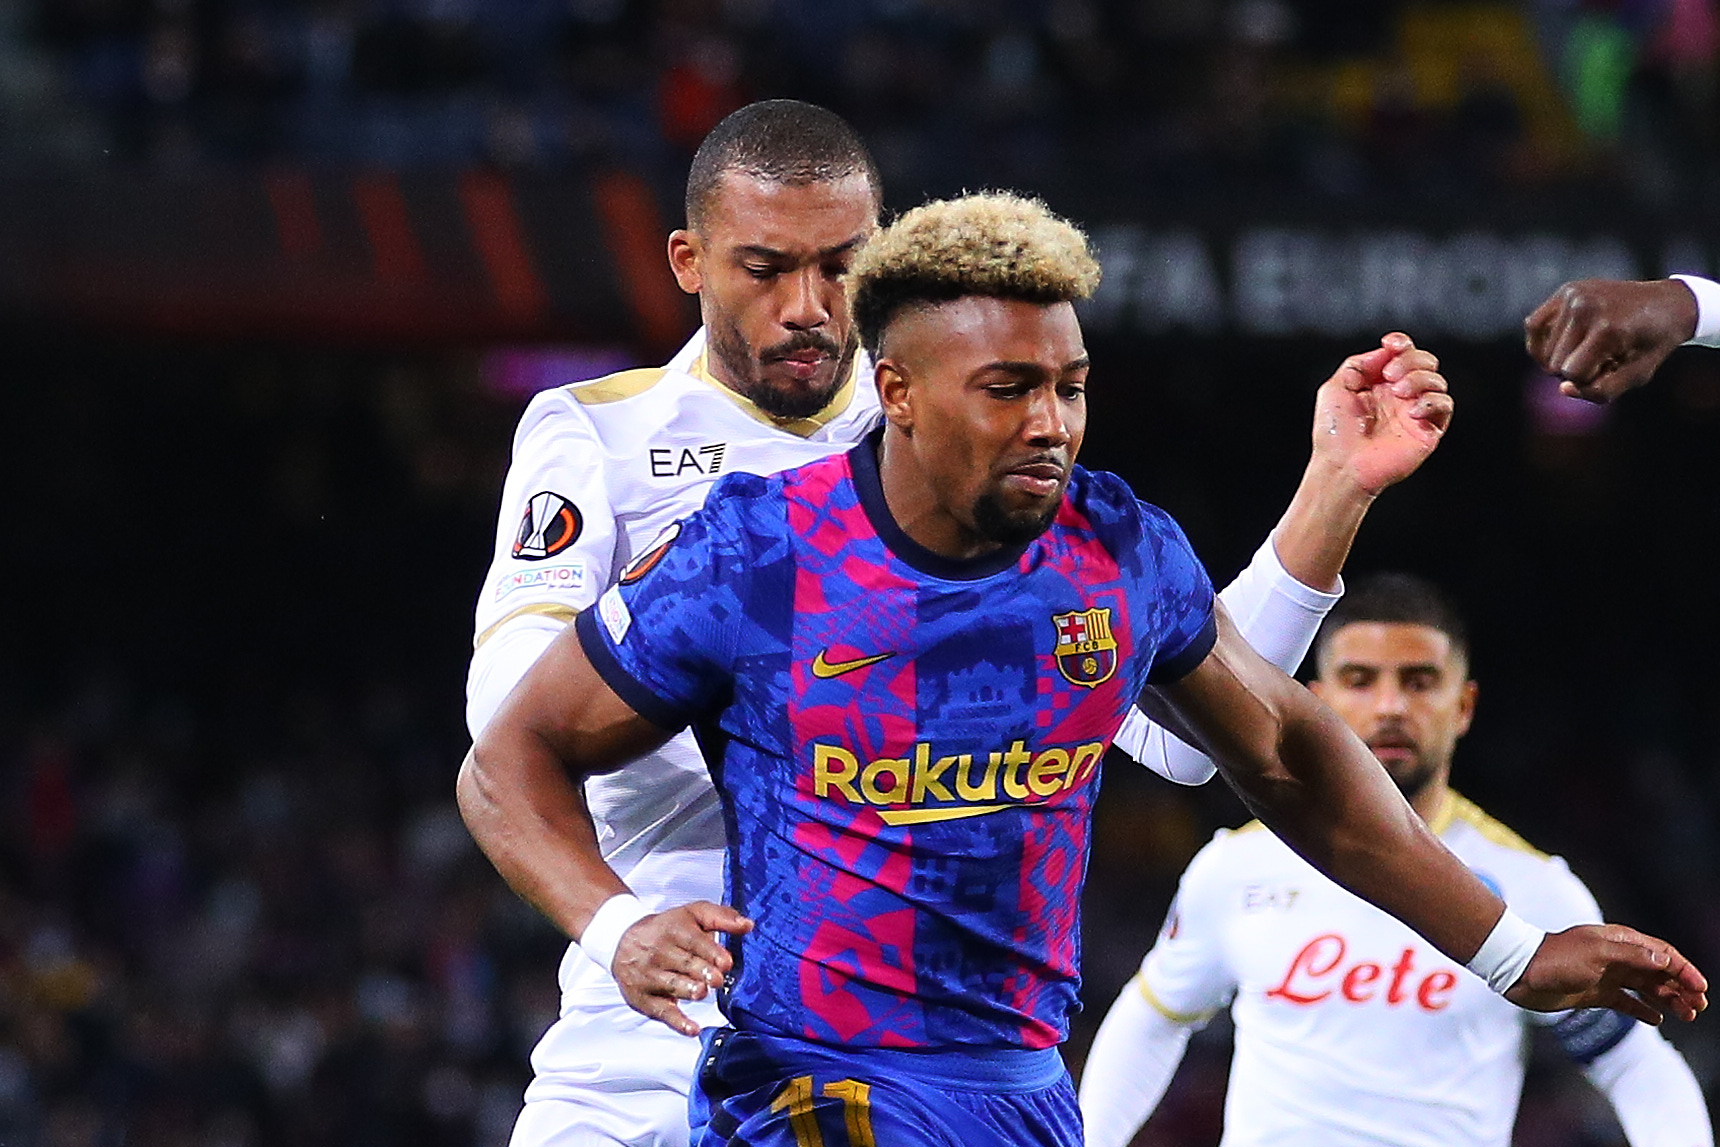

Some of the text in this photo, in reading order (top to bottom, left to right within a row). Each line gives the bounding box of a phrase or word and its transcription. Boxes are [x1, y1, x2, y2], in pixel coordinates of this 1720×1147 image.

[650, 443, 726, 477] EA7
[1075, 640, 1099, 652] FCB
[813, 740, 1104, 806] Rakuten
[1266, 933, 1458, 1012] Lete
